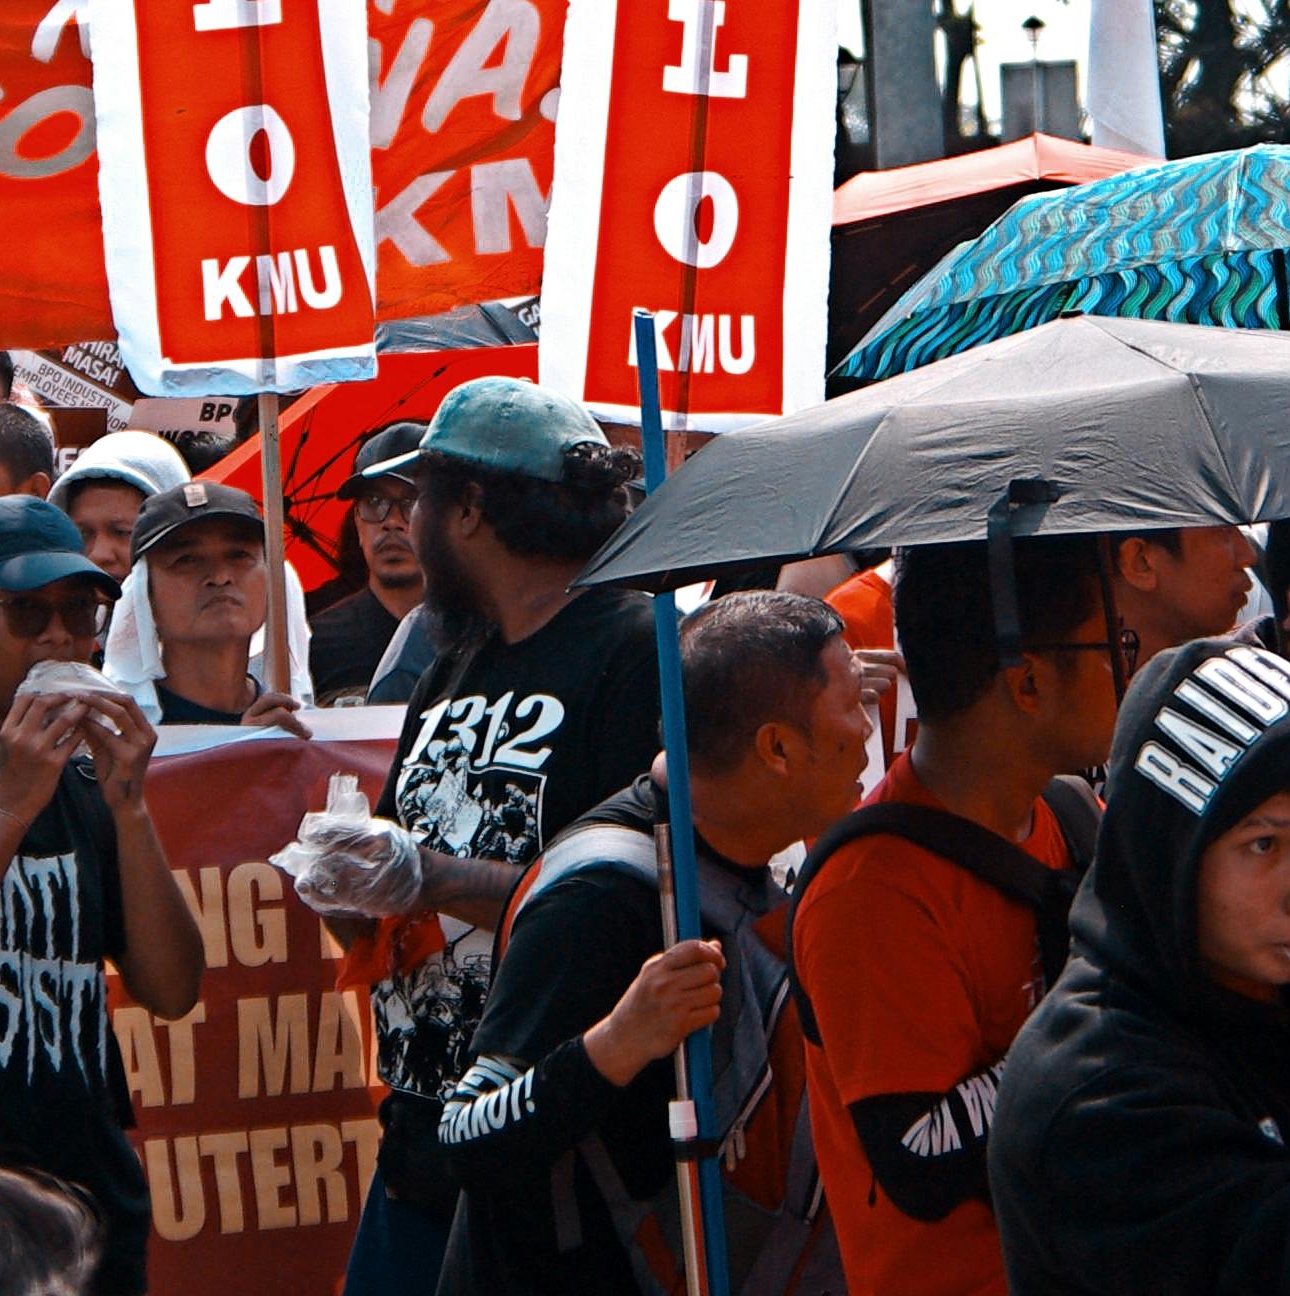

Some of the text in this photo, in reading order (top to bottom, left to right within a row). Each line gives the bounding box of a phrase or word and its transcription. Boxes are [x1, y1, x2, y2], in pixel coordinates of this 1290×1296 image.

[202, 245, 342, 321] KMU
[13, 366, 78, 408] EMPLOYEES
[37, 363, 119, 413] BPO INDUSTRY
[62, 346, 120, 388] MASA!
[199, 402, 237, 423] BP
[403, 691, 566, 770] 1312
